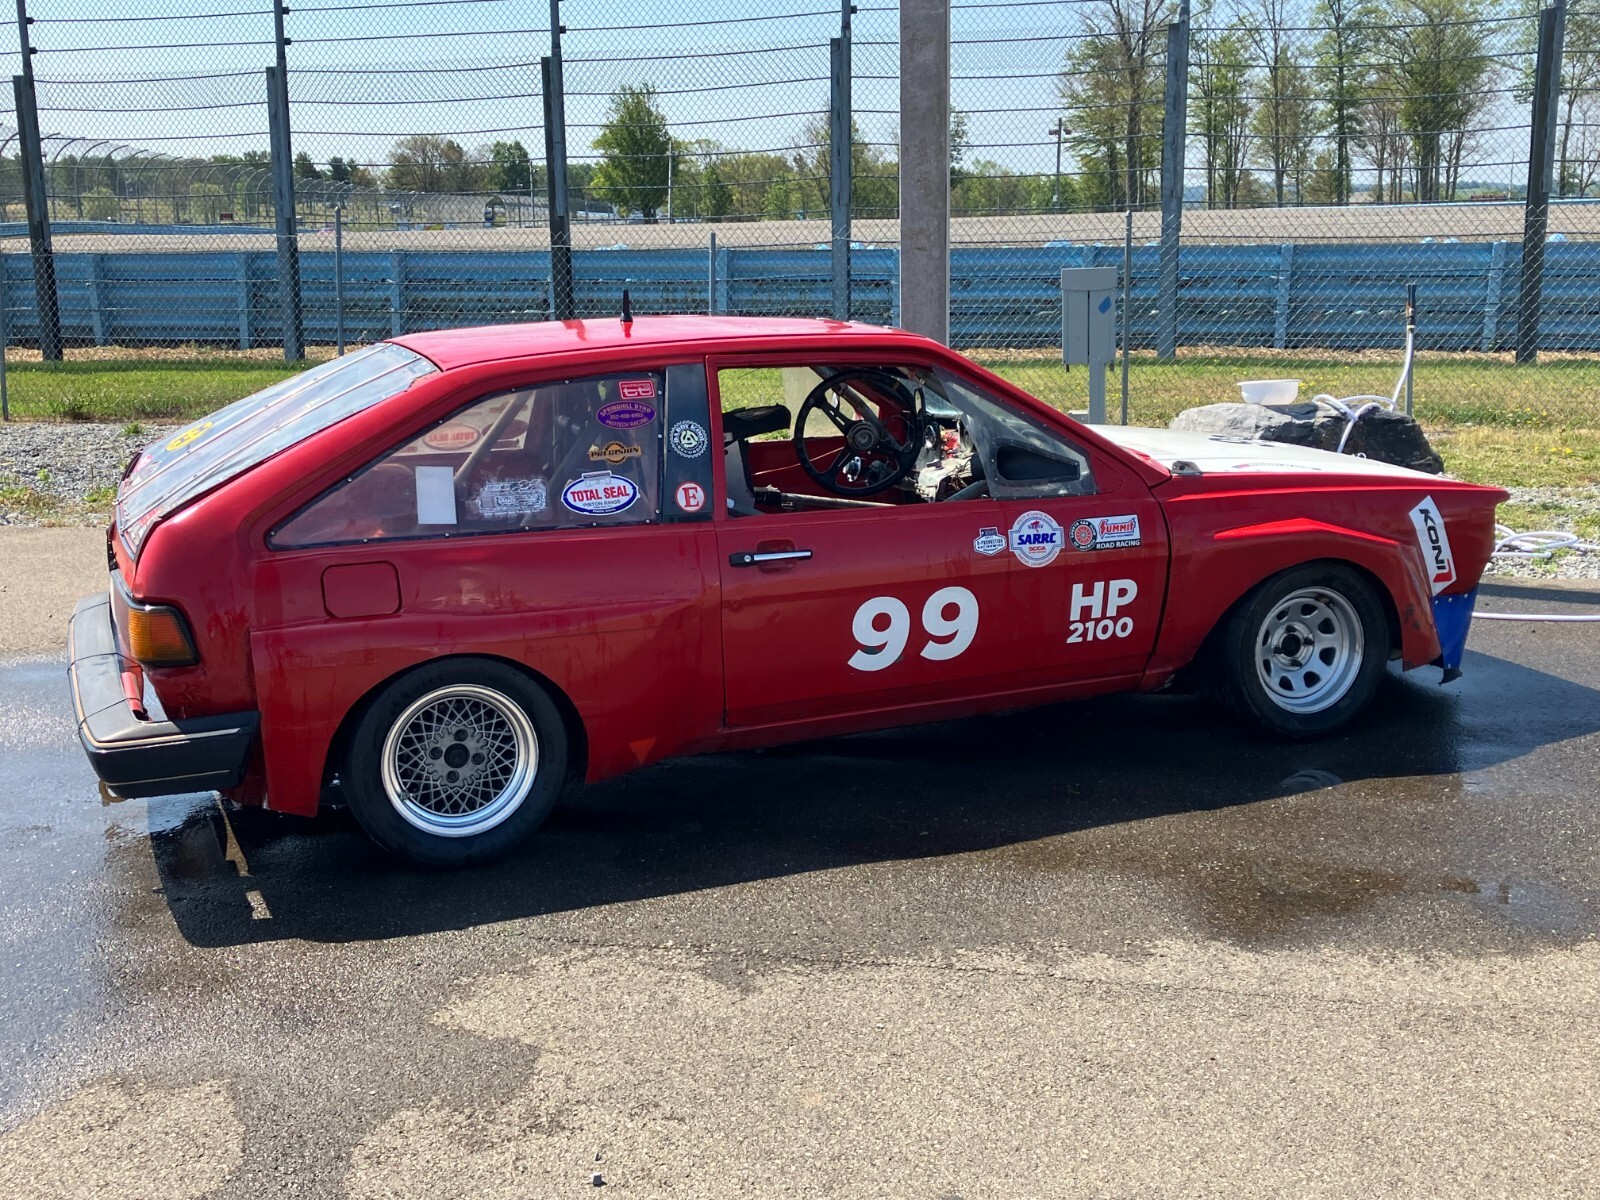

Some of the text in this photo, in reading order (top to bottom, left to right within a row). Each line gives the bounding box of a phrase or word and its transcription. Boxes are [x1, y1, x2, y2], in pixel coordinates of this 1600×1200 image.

[599, 403, 652, 417] SPRINGHILL DYNO
[591, 447, 640, 458] PRECISION
[570, 485, 631, 503] TOTAL SEAL
[682, 486, 700, 509] E
[1017, 532, 1057, 546] SARRC
[1096, 539, 1141, 550] ROAD RACING
[1418, 508, 1447, 571] KONI
[1069, 578, 1138, 621] HP
[847, 586, 980, 672] 99
[1066, 617, 1134, 644] 2100
